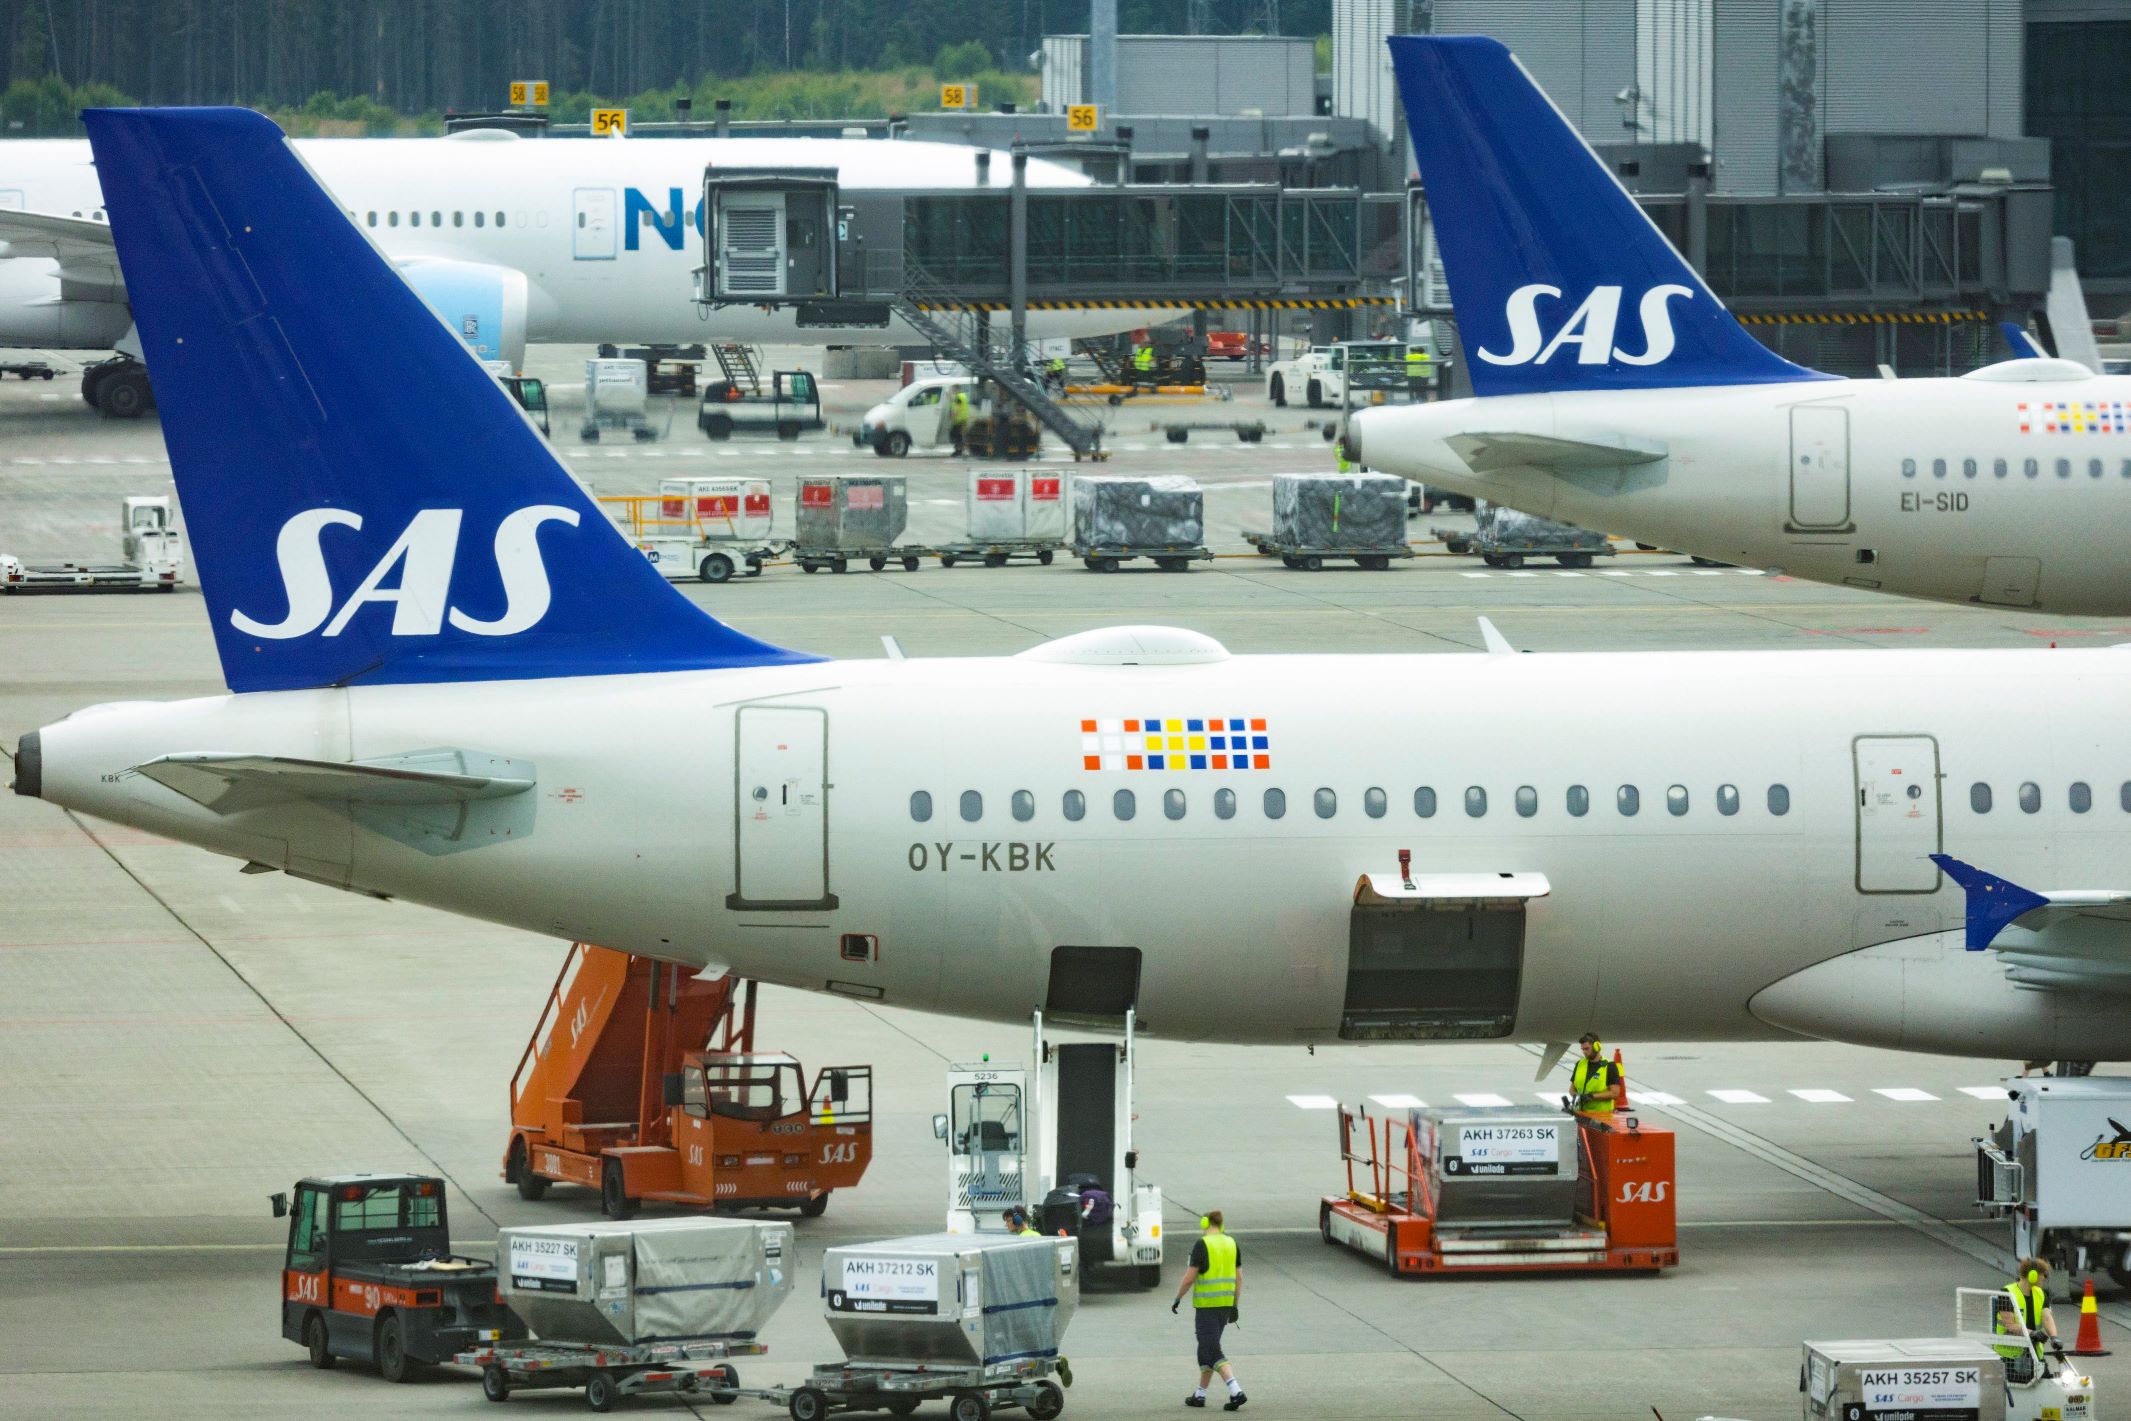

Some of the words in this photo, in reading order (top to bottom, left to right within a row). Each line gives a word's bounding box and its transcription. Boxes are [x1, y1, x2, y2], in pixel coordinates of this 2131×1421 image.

[512, 86, 525, 101] 58
[944, 88, 962, 103] 58
[598, 113, 621, 130] 56
[1071, 109, 1094, 126] 56
[624, 187, 704, 250] N
[1477, 284, 1694, 366] SAS
[1901, 491, 1969, 512] EI-SID
[230, 504, 581, 639] SAS
[101, 774, 121, 783] KBK
[908, 842, 1056, 872] OY-KBK
[570, 996, 587, 1050] SAS
[974, 1072, 998, 1080] 5236
[1463, 1129, 1493, 1140] AKH
[1496, 1129, 1534, 1140] 37263
[1536, 1128, 1555, 1139] SK
[689, 1144, 704, 1166] SAS
[818, 1142, 859, 1165] SAS
[1471, 1148, 1488, 1156] SAS
[1490, 1148, 1512, 1158] Cargo
[545, 1152, 561, 1175] 3001
[1480, 1164, 1505, 1174] unilode
[1615, 1181, 1670, 1203] SAS
[511, 1240, 532, 1252] AKH
[535, 1242, 561, 1255] 35227
[563, 1244, 577, 1256] SK
[847, 1262, 874, 1274] AKH
[878, 1262, 913, 1275] 37212
[916, 1263, 934, 1276] SK
[297, 1274, 320, 1301] SAS
[364, 1285, 381, 1309] 90
[1863, 1373, 1898, 1386] AKH
[1903, 1372, 1950, 1385] 35257
[1955, 1371, 1978, 1384] SK
[1874, 1394, 1894, 1402] SAS
[1898, 1393, 1923, 1405] Cargo
